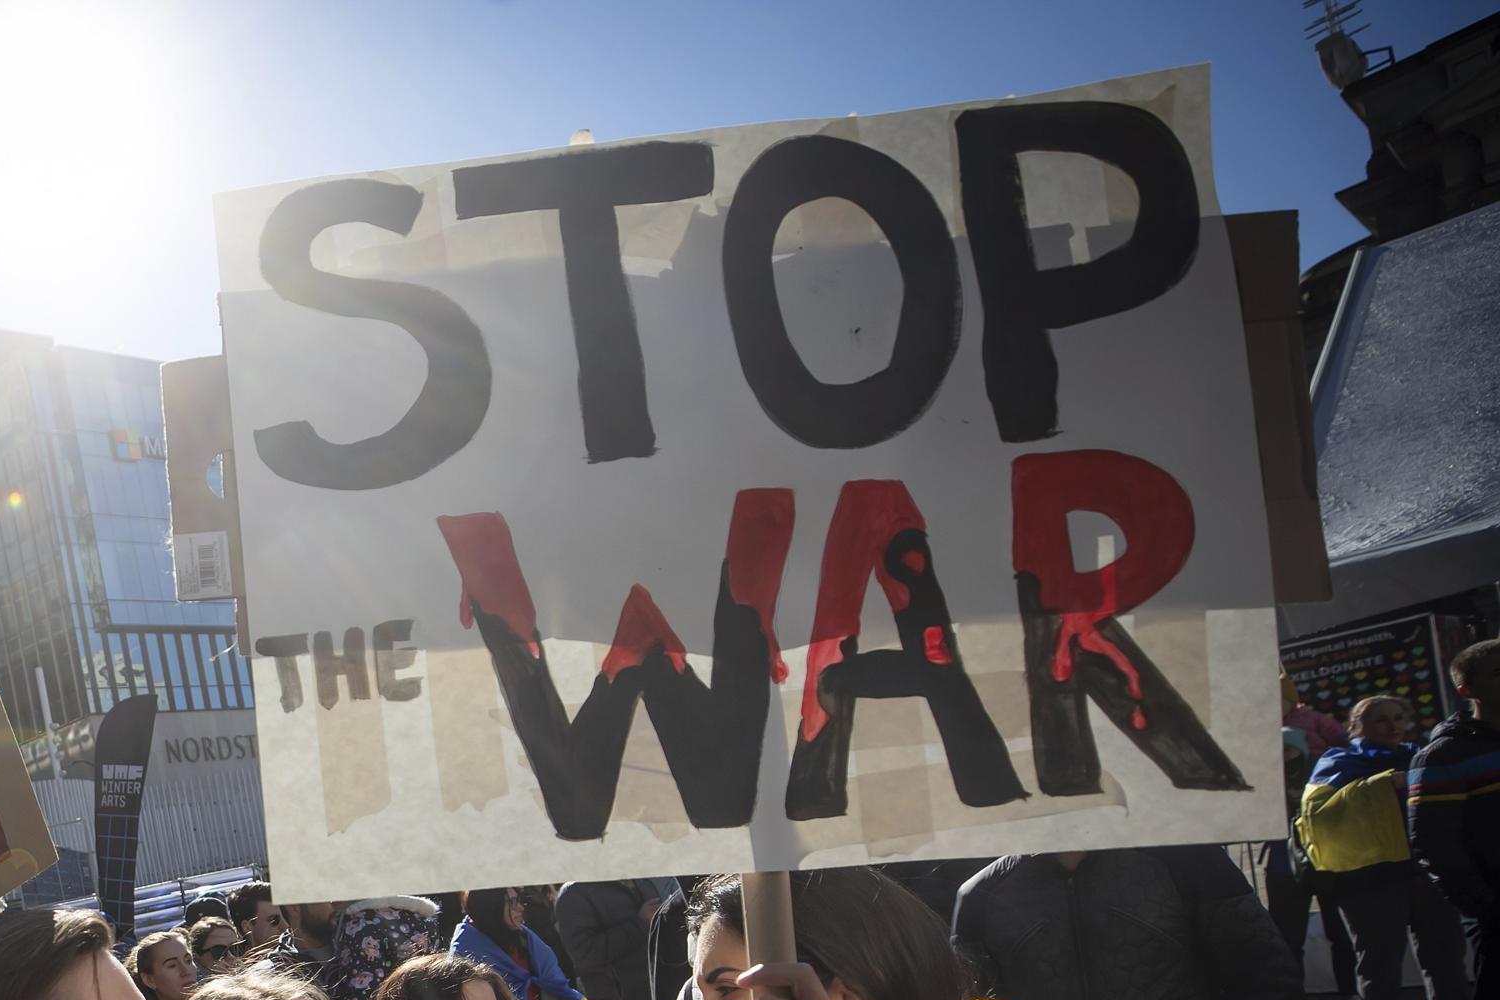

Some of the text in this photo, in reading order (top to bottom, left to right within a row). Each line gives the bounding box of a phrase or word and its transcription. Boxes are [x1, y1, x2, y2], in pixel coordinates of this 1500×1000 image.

[253, 101, 1200, 490] STOP
[255, 449, 1254, 840] THE WAR
[164, 734, 257, 764] NORDST
[101, 795, 126, 808] ARTS
[102, 781, 141, 795] WINTER
